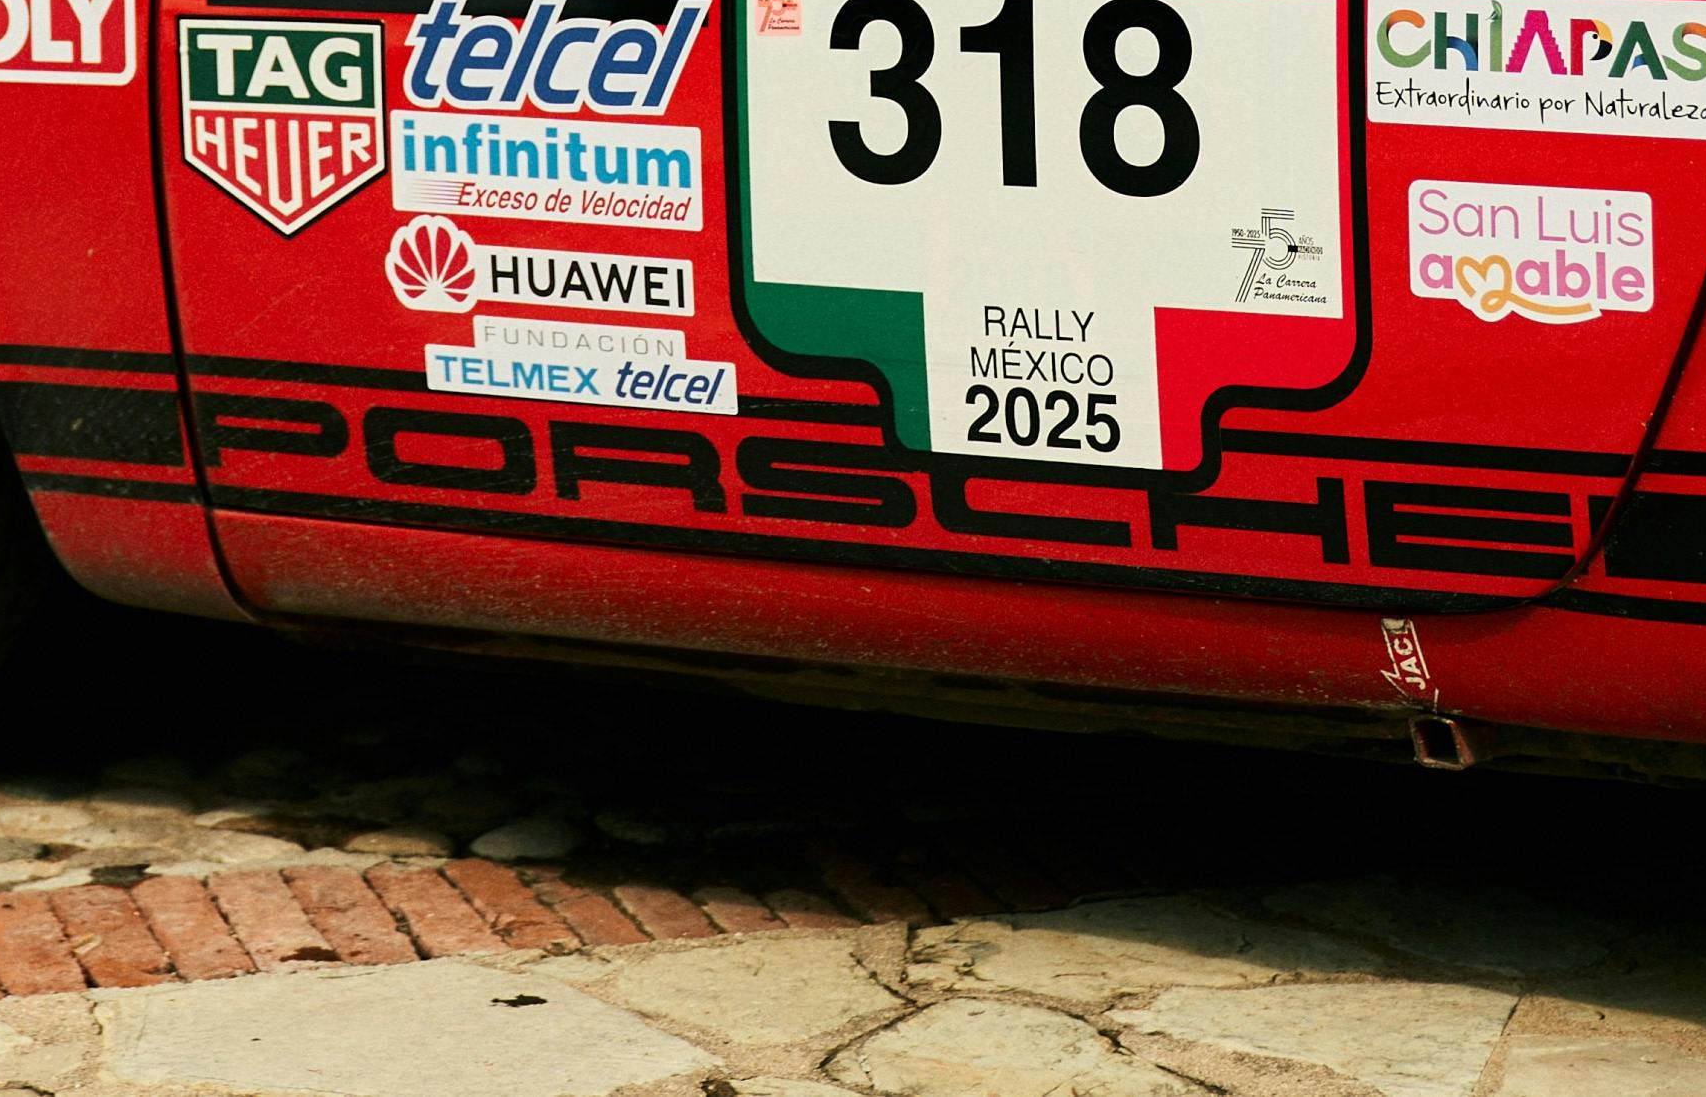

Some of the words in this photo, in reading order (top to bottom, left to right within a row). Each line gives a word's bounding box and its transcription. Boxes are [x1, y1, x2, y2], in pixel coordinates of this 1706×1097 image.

[196, 34, 364, 103] TAG
[406, 0, 704, 108] telcel
[1376, 77, 1531, 115] Extraordinario
[1538, 97, 1577, 124] por
[195, 115, 373, 217] HEUER
[402, 119, 693, 189] infinitum
[456, 182, 538, 211] Exceso
[544, 188, 572, 213] de
[581, 189, 692, 222] Velocidad
[1418, 188, 1521, 240] San
[1537, 195, 1646, 247] Luis
[490, 253, 687, 309] HUAWEI
[1253, 287, 1328, 304] Panamericana
[1256, 273, 1272, 285] La
[1276, 274, 1318, 289] Carrera
[1418, 248, 1646, 315] amable
[483, 324, 675, 358] FUNDACIÓN
[983, 305, 1095, 343] RALLY
[434, 354, 601, 396] TELMEX
[615, 360, 725, 405] telcel
[970, 341, 1115, 387] MÉXICO
[965, 383, 1122, 454] 2025
[192, 391, 1576, 576] PORSCHE
